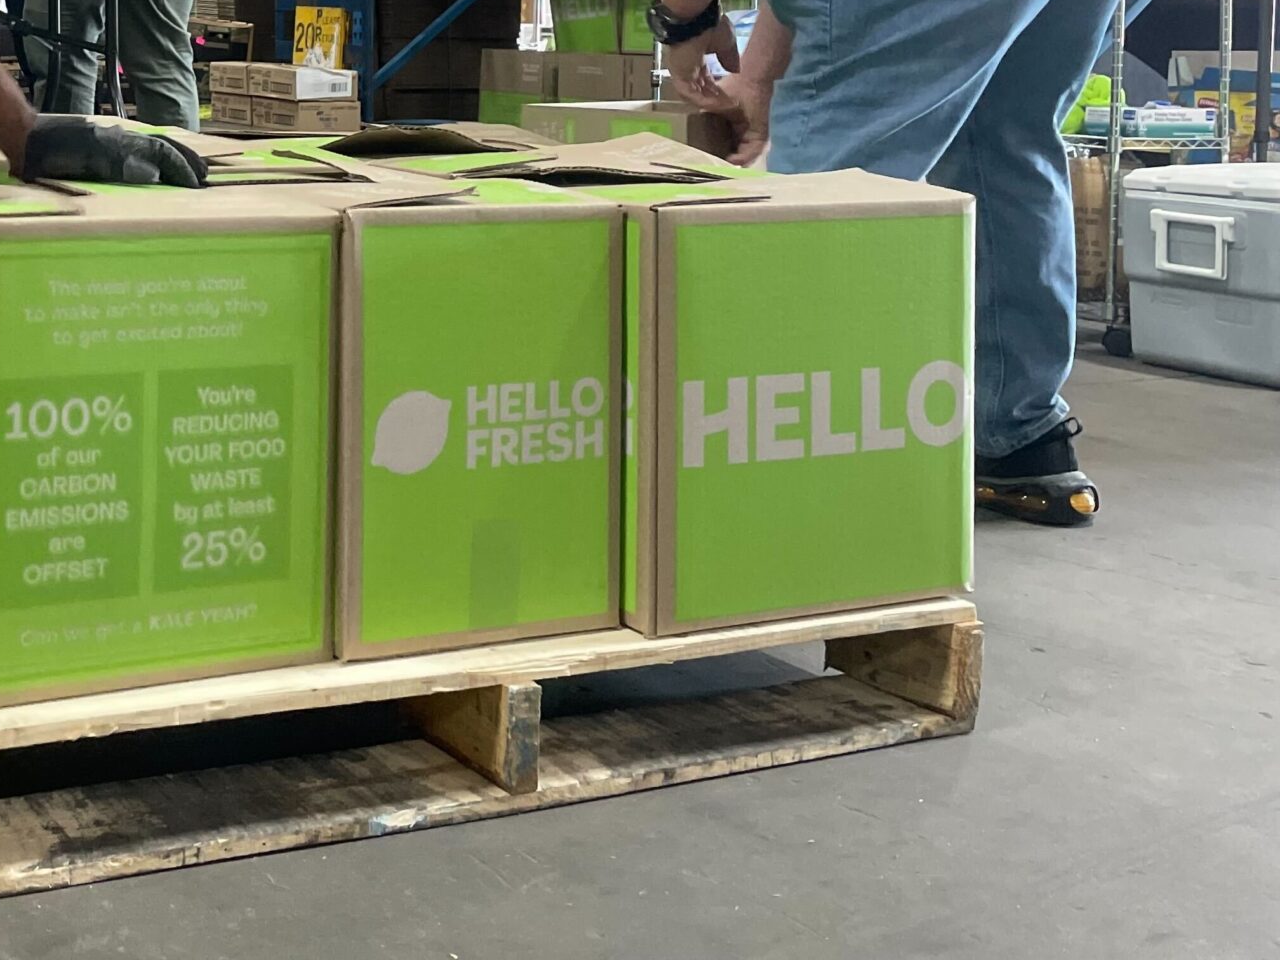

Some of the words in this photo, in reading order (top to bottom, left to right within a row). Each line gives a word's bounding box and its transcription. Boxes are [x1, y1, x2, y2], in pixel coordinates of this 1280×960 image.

[49, 280, 80, 297] The
[196, 275, 247, 292] about
[25, 307, 45, 322] to
[53, 303, 100, 320] make
[149, 300, 178, 317] the
[185, 298, 220, 319] only
[224, 296, 268, 317] thing
[53, 330, 71, 344] to
[77, 328, 108, 349] get
[197, 385, 256, 407] You're
[466, 376, 605, 427] HELLO
[5, 395, 132, 441] 100%
[173, 410, 279, 435] REDUCING
[682, 359, 972, 470] HELLO
[164, 442, 222, 466] YOUR
[228, 438, 286, 460] FOOD
[466, 417, 605, 470] FRESH
[36, 446, 61, 468] of
[66, 448, 101, 466] our
[20, 473, 117, 499] CARBON
[190, 467, 262, 492] WASTE
[5, 500, 130, 532] EMISSIONS
[173, 501, 198, 525] by
[203, 500, 224, 519] at
[228, 496, 276, 517] least
[48, 535, 86, 554] are
[181, 525, 266, 570] 25%
[23, 557, 108, 586] OFFSET
[148, 610, 195, 632] KALE
